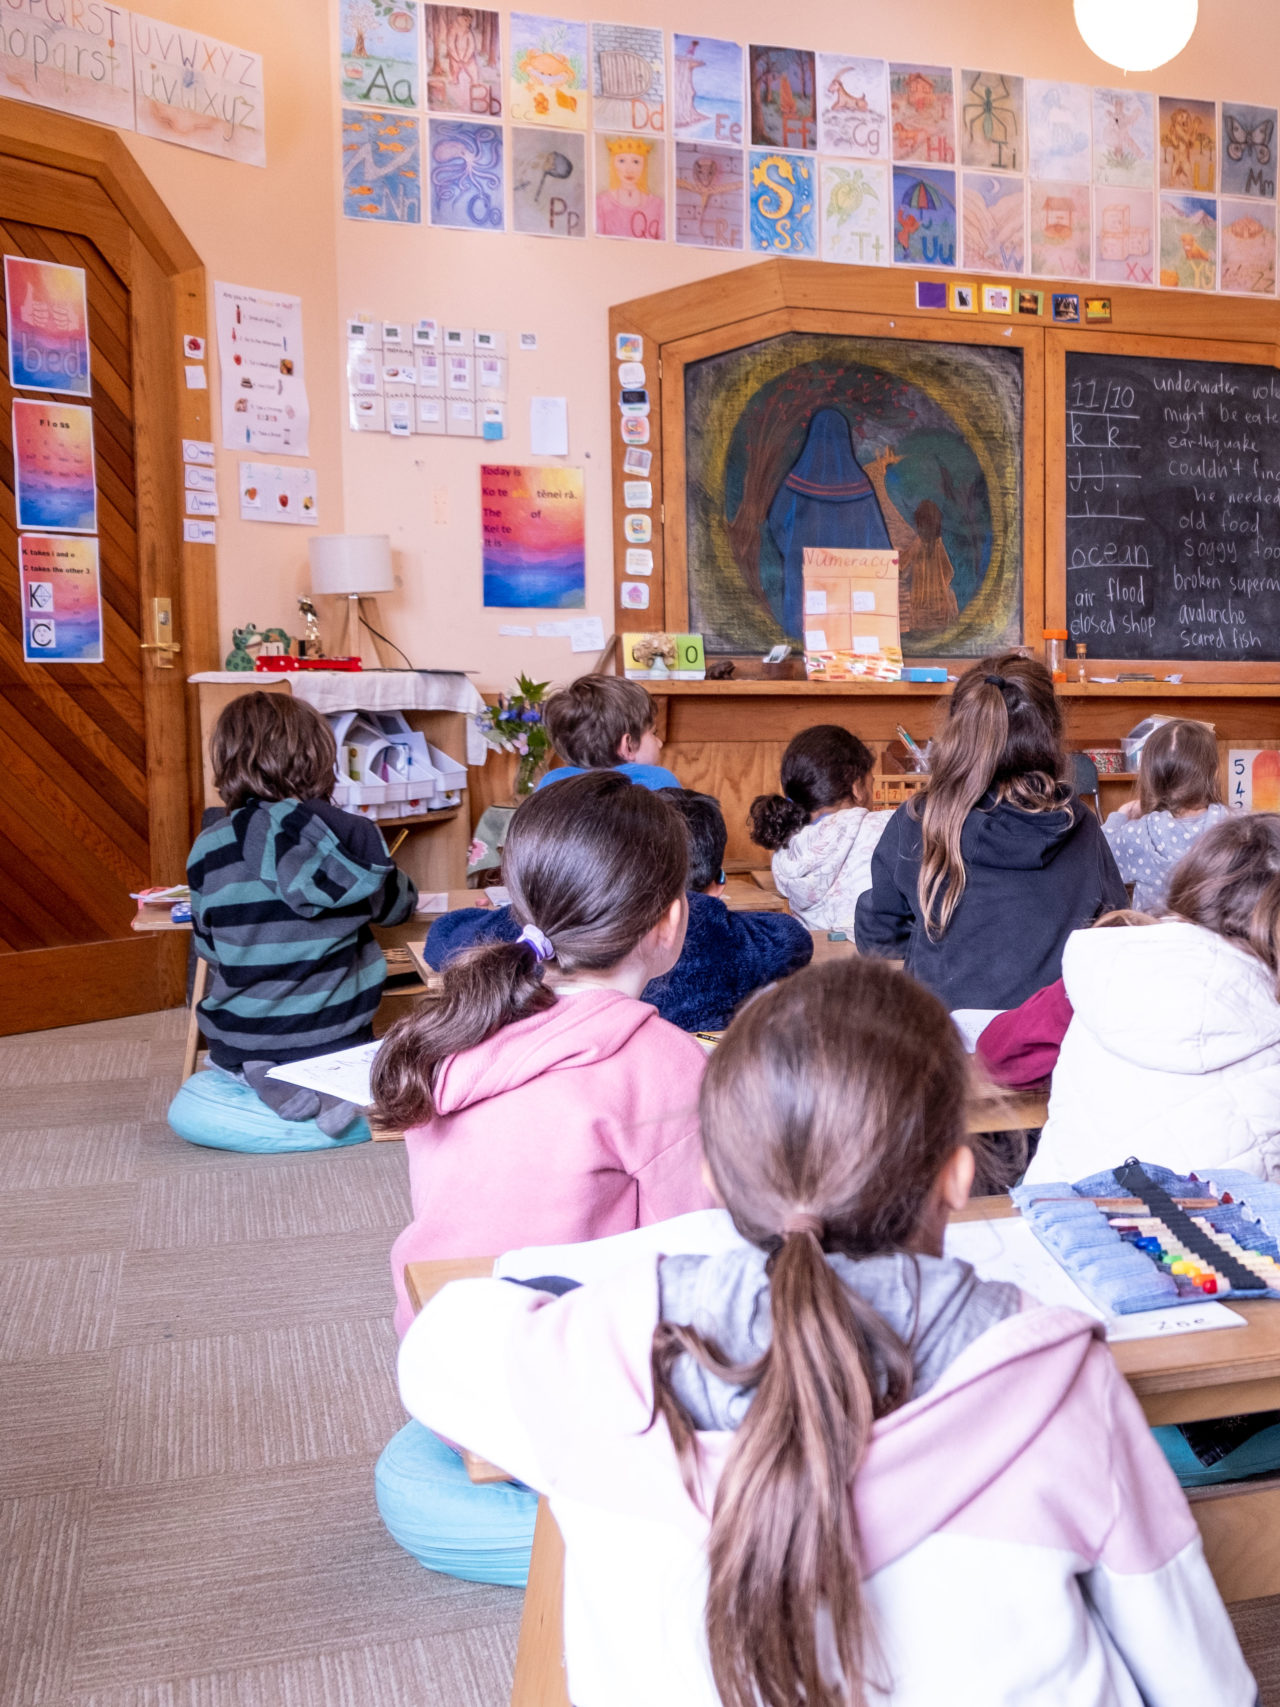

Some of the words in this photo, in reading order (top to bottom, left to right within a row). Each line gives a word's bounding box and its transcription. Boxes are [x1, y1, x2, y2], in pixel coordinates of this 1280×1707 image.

[363, 64, 415, 106] Aa
[469, 84, 501, 116] Bb
[631, 99, 664, 131] Dd
[1246, 167, 1275, 198] Mm
[550, 197, 579, 237] Pp
[774, 219, 804, 251] Ss
[22, 332, 84, 378] bed
[1071, 379, 1135, 413] 11/10
[1153, 370, 1239, 396] underwater
[1164, 402, 1206, 433] might
[1220, 402, 1238, 423] be
[1168, 433, 1259, 456] earthquake
[482, 466, 511, 478] Today
[513, 467, 521, 477] is
[1168, 457, 1243, 479] couldn't
[482, 488, 495, 497] Ko
[498, 489, 508, 497] te
[537, 489, 562, 499] tēnei
[1194, 486, 1216, 502] he
[483, 508, 502, 517] The
[530, 510, 542, 519] of
[1179, 510, 1207, 530] old
[1221, 509, 1260, 536] food
[483, 525, 500, 534] Kei
[501, 525, 512, 533] te
[494, 539, 502, 547] is
[1071, 542, 1150, 568] ocean
[804, 549, 891, 578] Numeracy
[1174, 564, 1221, 590] broken
[1075, 588, 1096, 607] air
[1106, 575, 1145, 606] flood
[1122, 610, 1156, 638] shop
[1179, 598, 1247, 625] avalanche
[32, 623, 52, 647] C
[1232, 628, 1262, 649] fish
[1234, 758, 1245, 775] 5
[1235, 780, 1246, 798] 4
